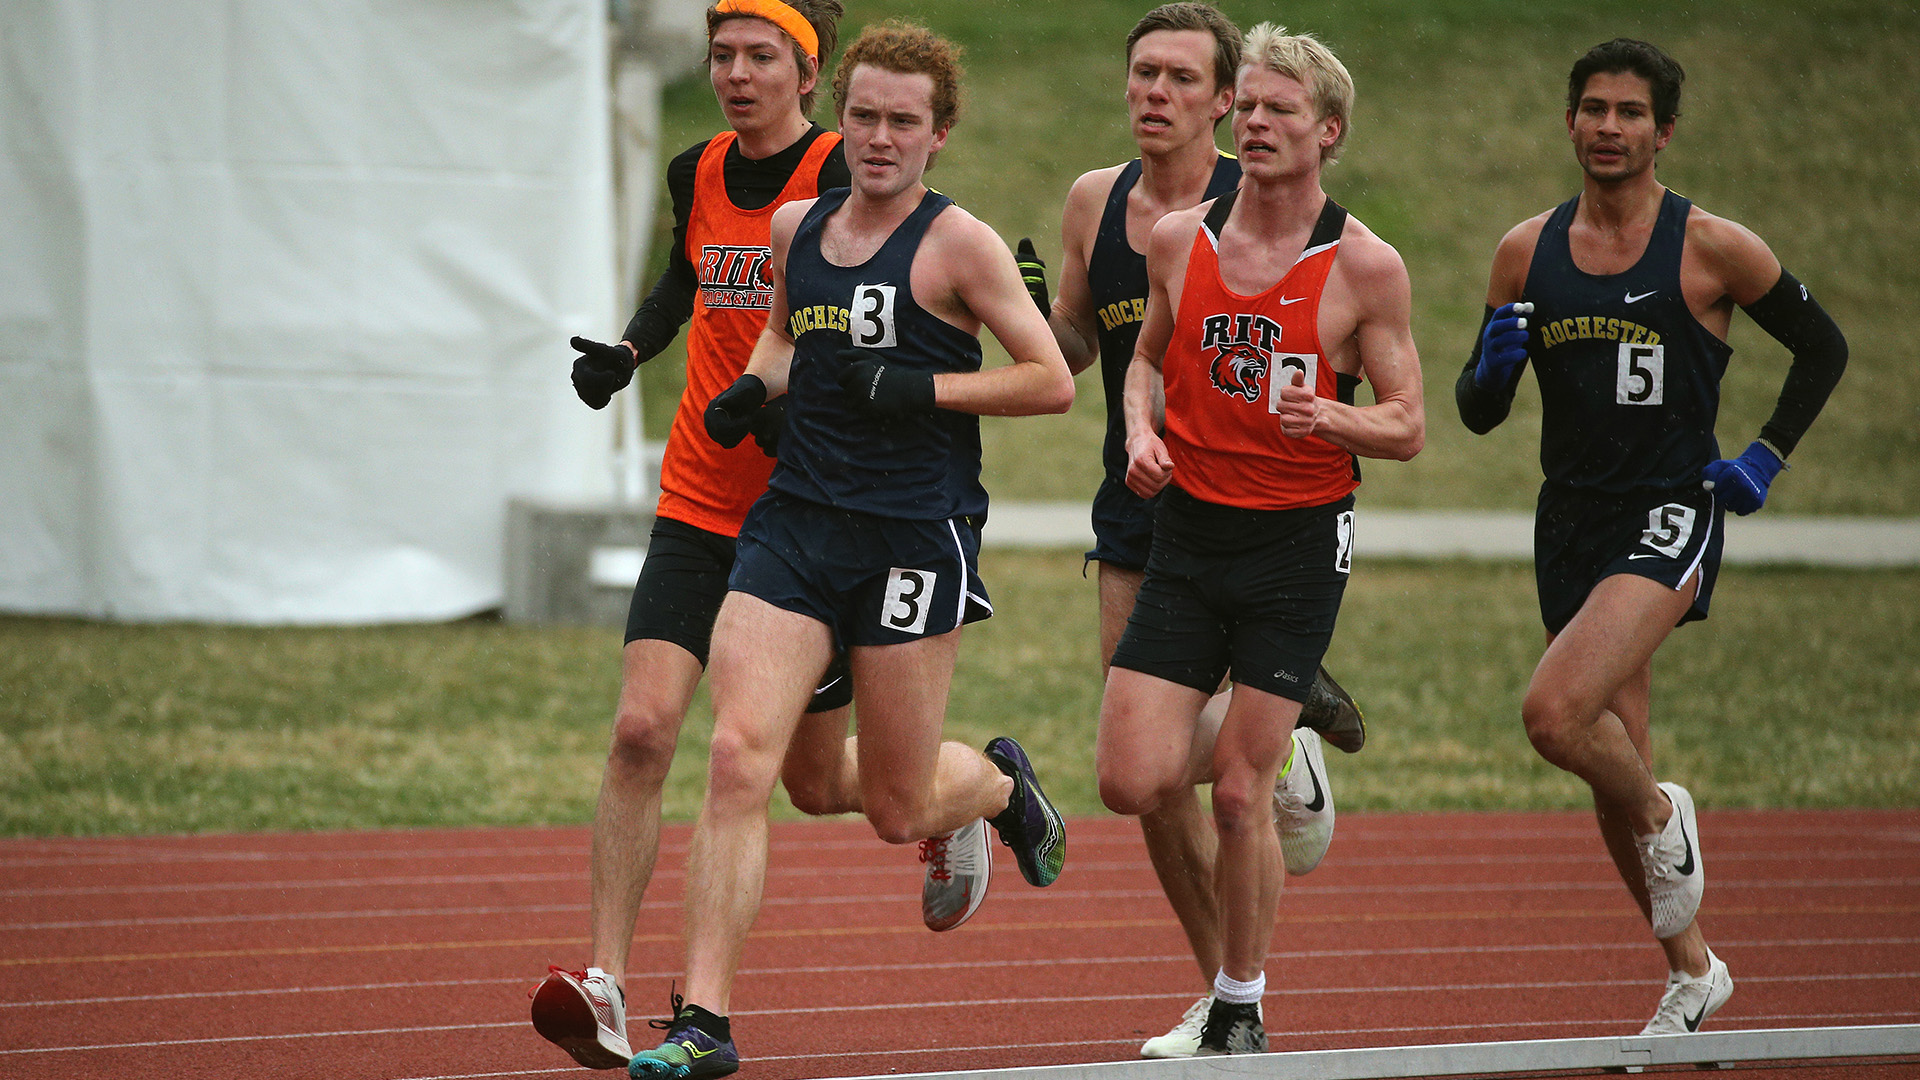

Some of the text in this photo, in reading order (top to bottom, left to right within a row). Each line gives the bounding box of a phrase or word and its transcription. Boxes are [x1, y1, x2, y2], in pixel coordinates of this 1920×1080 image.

[700, 249, 763, 286] RIT
[733, 293, 744, 306] &
[860, 288, 885, 345] 3
[1098, 297, 1145, 331] ROCH
[789, 305, 853, 340] ROCHES
[1201, 313, 1283, 353] RIT
[1540, 316, 1661, 349] ROCHESTER
[869, 385, 878, 400] new
[1627, 347, 1654, 402] 5
[1339, 513, 1352, 570] 2
[1649, 506, 1686, 547] 5
[889, 571, 925, 628] 3
